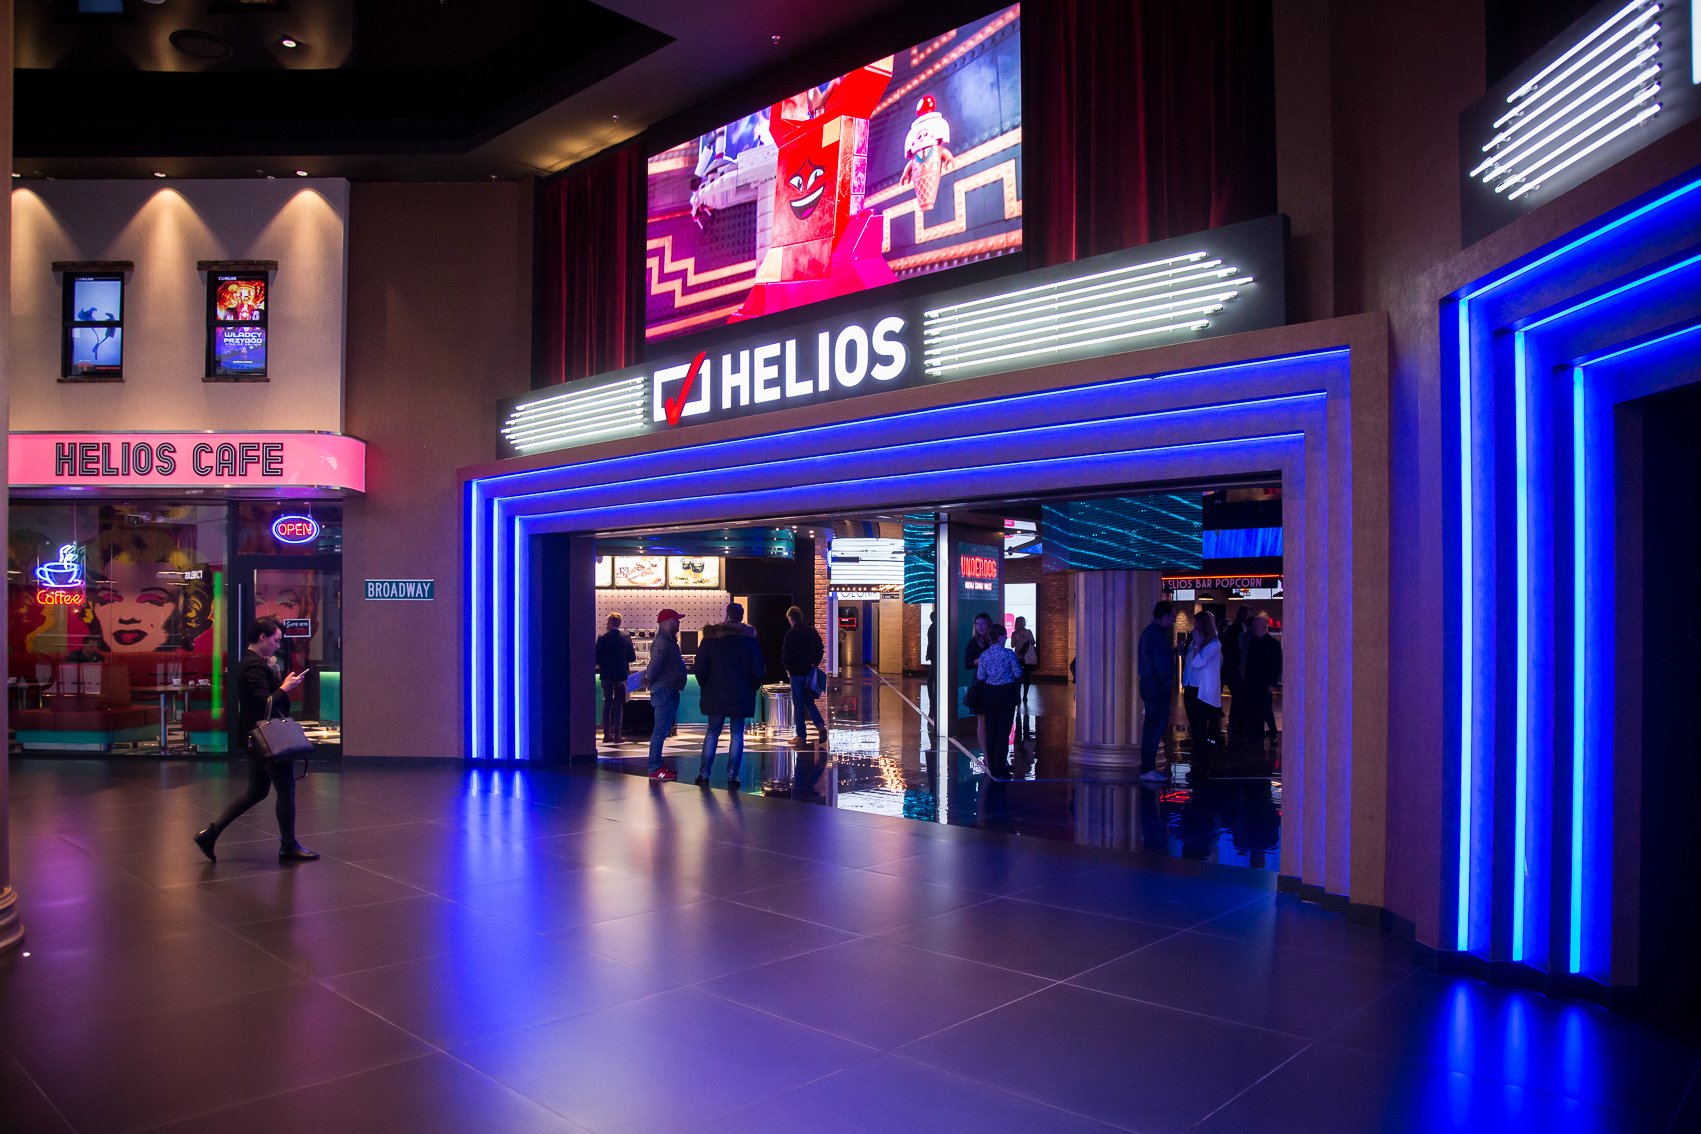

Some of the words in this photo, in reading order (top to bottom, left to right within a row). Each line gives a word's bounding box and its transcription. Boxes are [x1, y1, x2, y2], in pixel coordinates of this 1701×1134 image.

[721, 316, 907, 410] HELIOS
[55, 442, 177, 476] HELIOS
[192, 442, 284, 476] CAFE
[278, 523, 312, 536] OPEN
[367, 582, 431, 598] BROADWAY
[1195, 579, 1212, 589] BAR
[1215, 578, 1262, 588] POPCORN
[36, 589, 83, 605] Coffee
